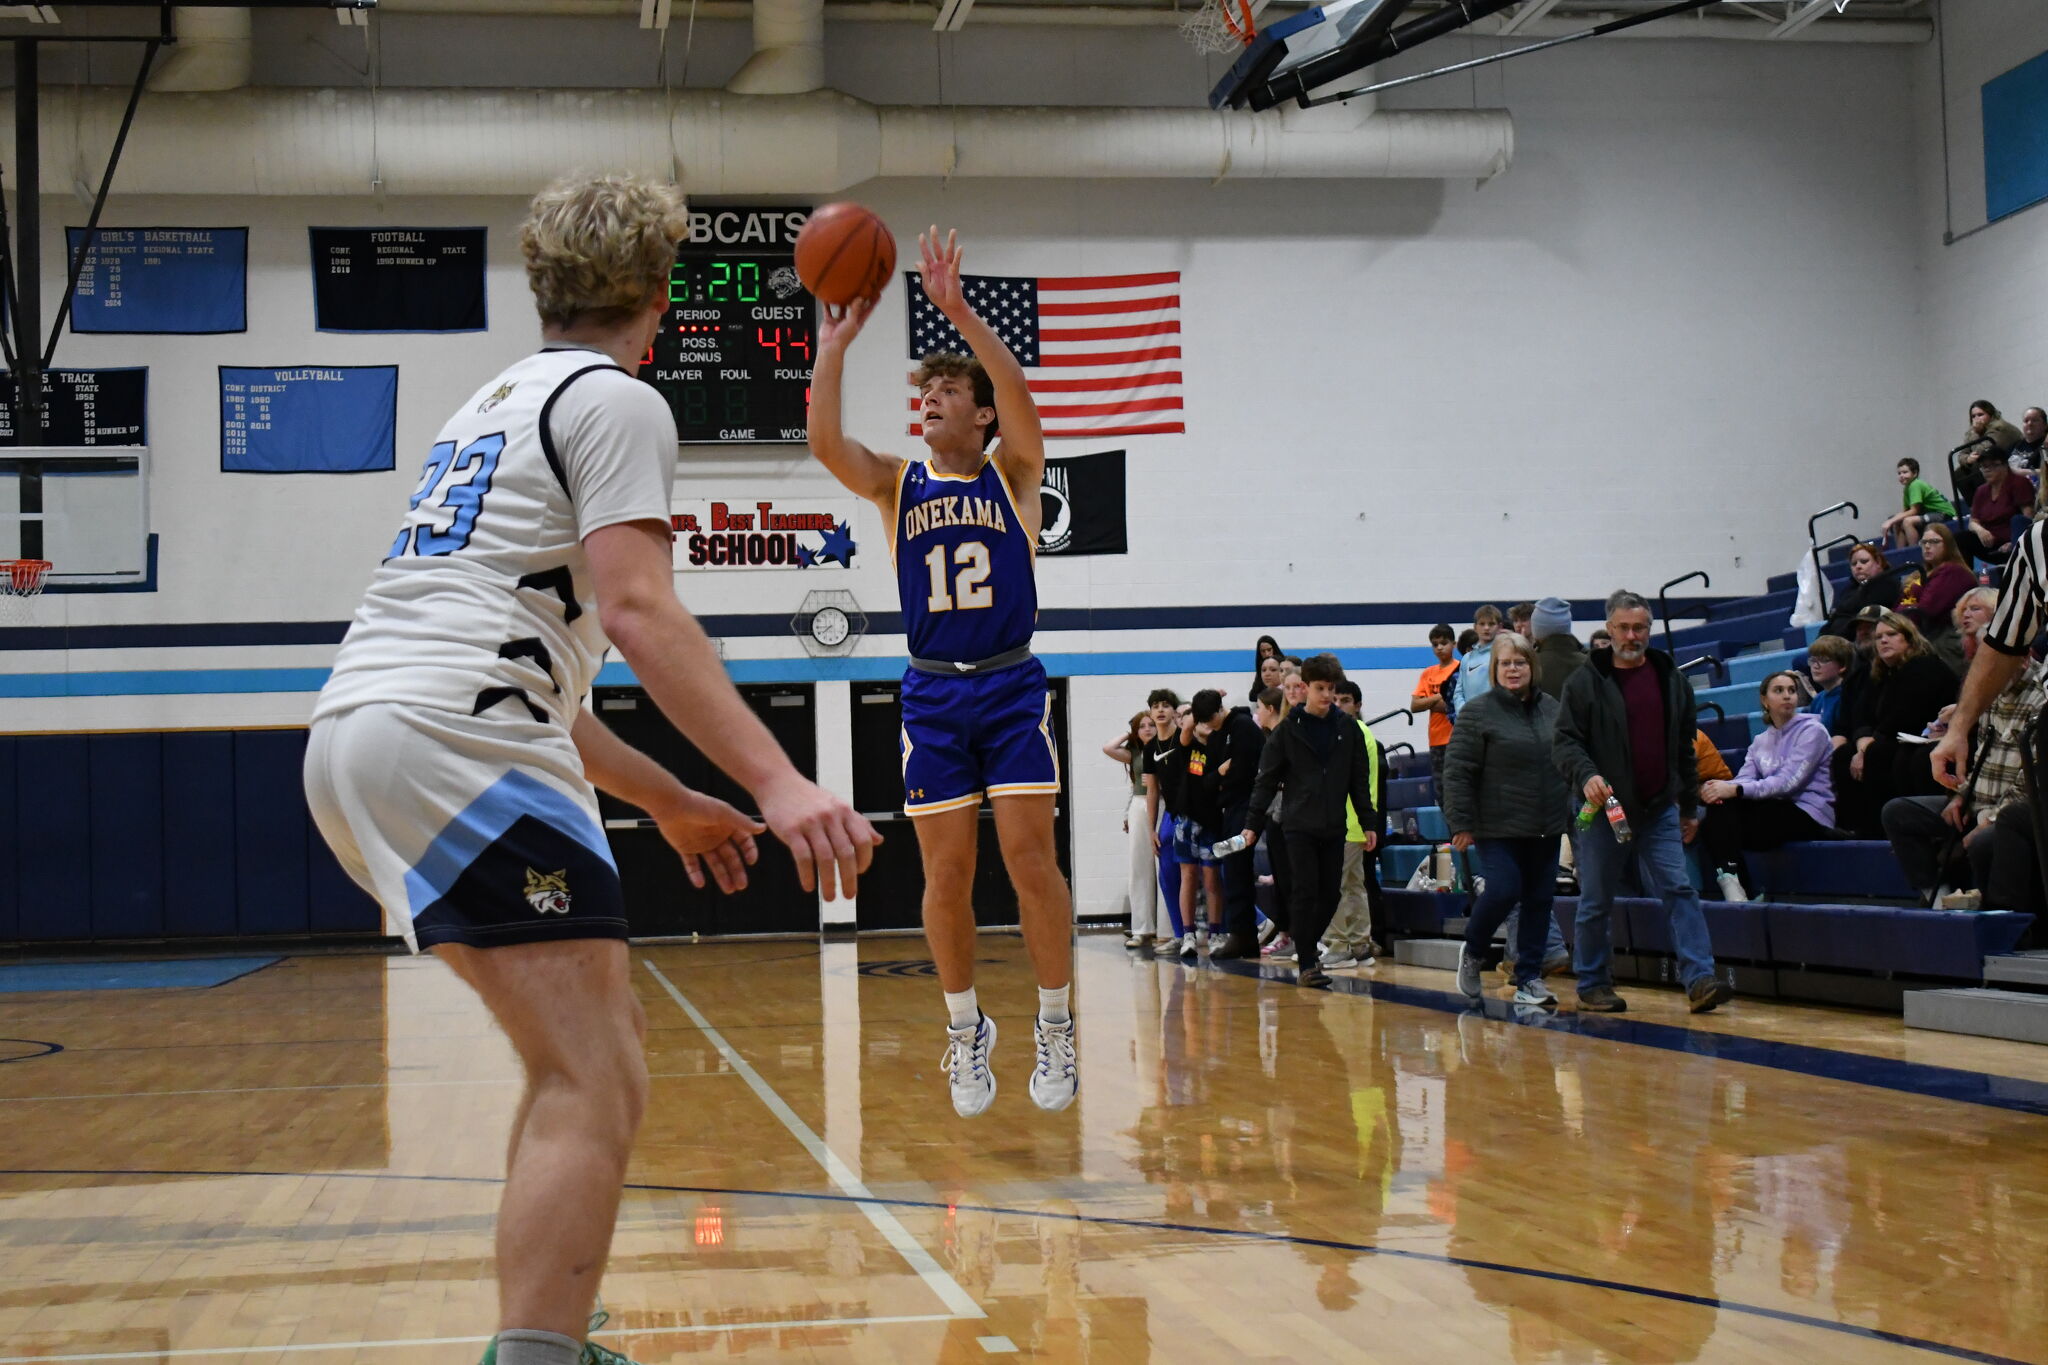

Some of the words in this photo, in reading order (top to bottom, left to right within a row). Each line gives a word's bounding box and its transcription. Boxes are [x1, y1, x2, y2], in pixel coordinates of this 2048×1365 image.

[689, 212, 808, 244] BCATS
[101, 232, 135, 242] GIRL'S
[144, 231, 213, 243] BASKETBALL
[371, 232, 425, 242] FOOTBALL
[101, 246, 136, 254] DISTRICT
[144, 246, 182, 254] REGIONAL
[377, 246, 415, 254] REGIONAL
[442, 246, 467, 254] STATE
[427, 257, 437, 265] UP
[676, 309, 721, 321] PERIOD
[751, 306, 804, 320] GUEST
[682, 337, 719, 349] POSS.
[680, 352, 722, 363] BONUS
[60, 373, 95, 383] TRACK
[274, 369, 344, 381] VOLLEYBALL
[656, 369, 703, 381] PLAYER
[720, 369, 752, 381] FOUL
[774, 369, 813, 380] FOULS
[75, 384, 99, 392] STATE
[250, 384, 287, 392] DISTRICT
[96, 426, 128, 435] RUNNER
[129, 425, 139, 434] UP
[719, 429, 756, 440] GAME
[905, 496, 1007, 541] ONEKAMA
[689, 533, 803, 566] SCHOOL
[924, 541, 993, 613] 12
